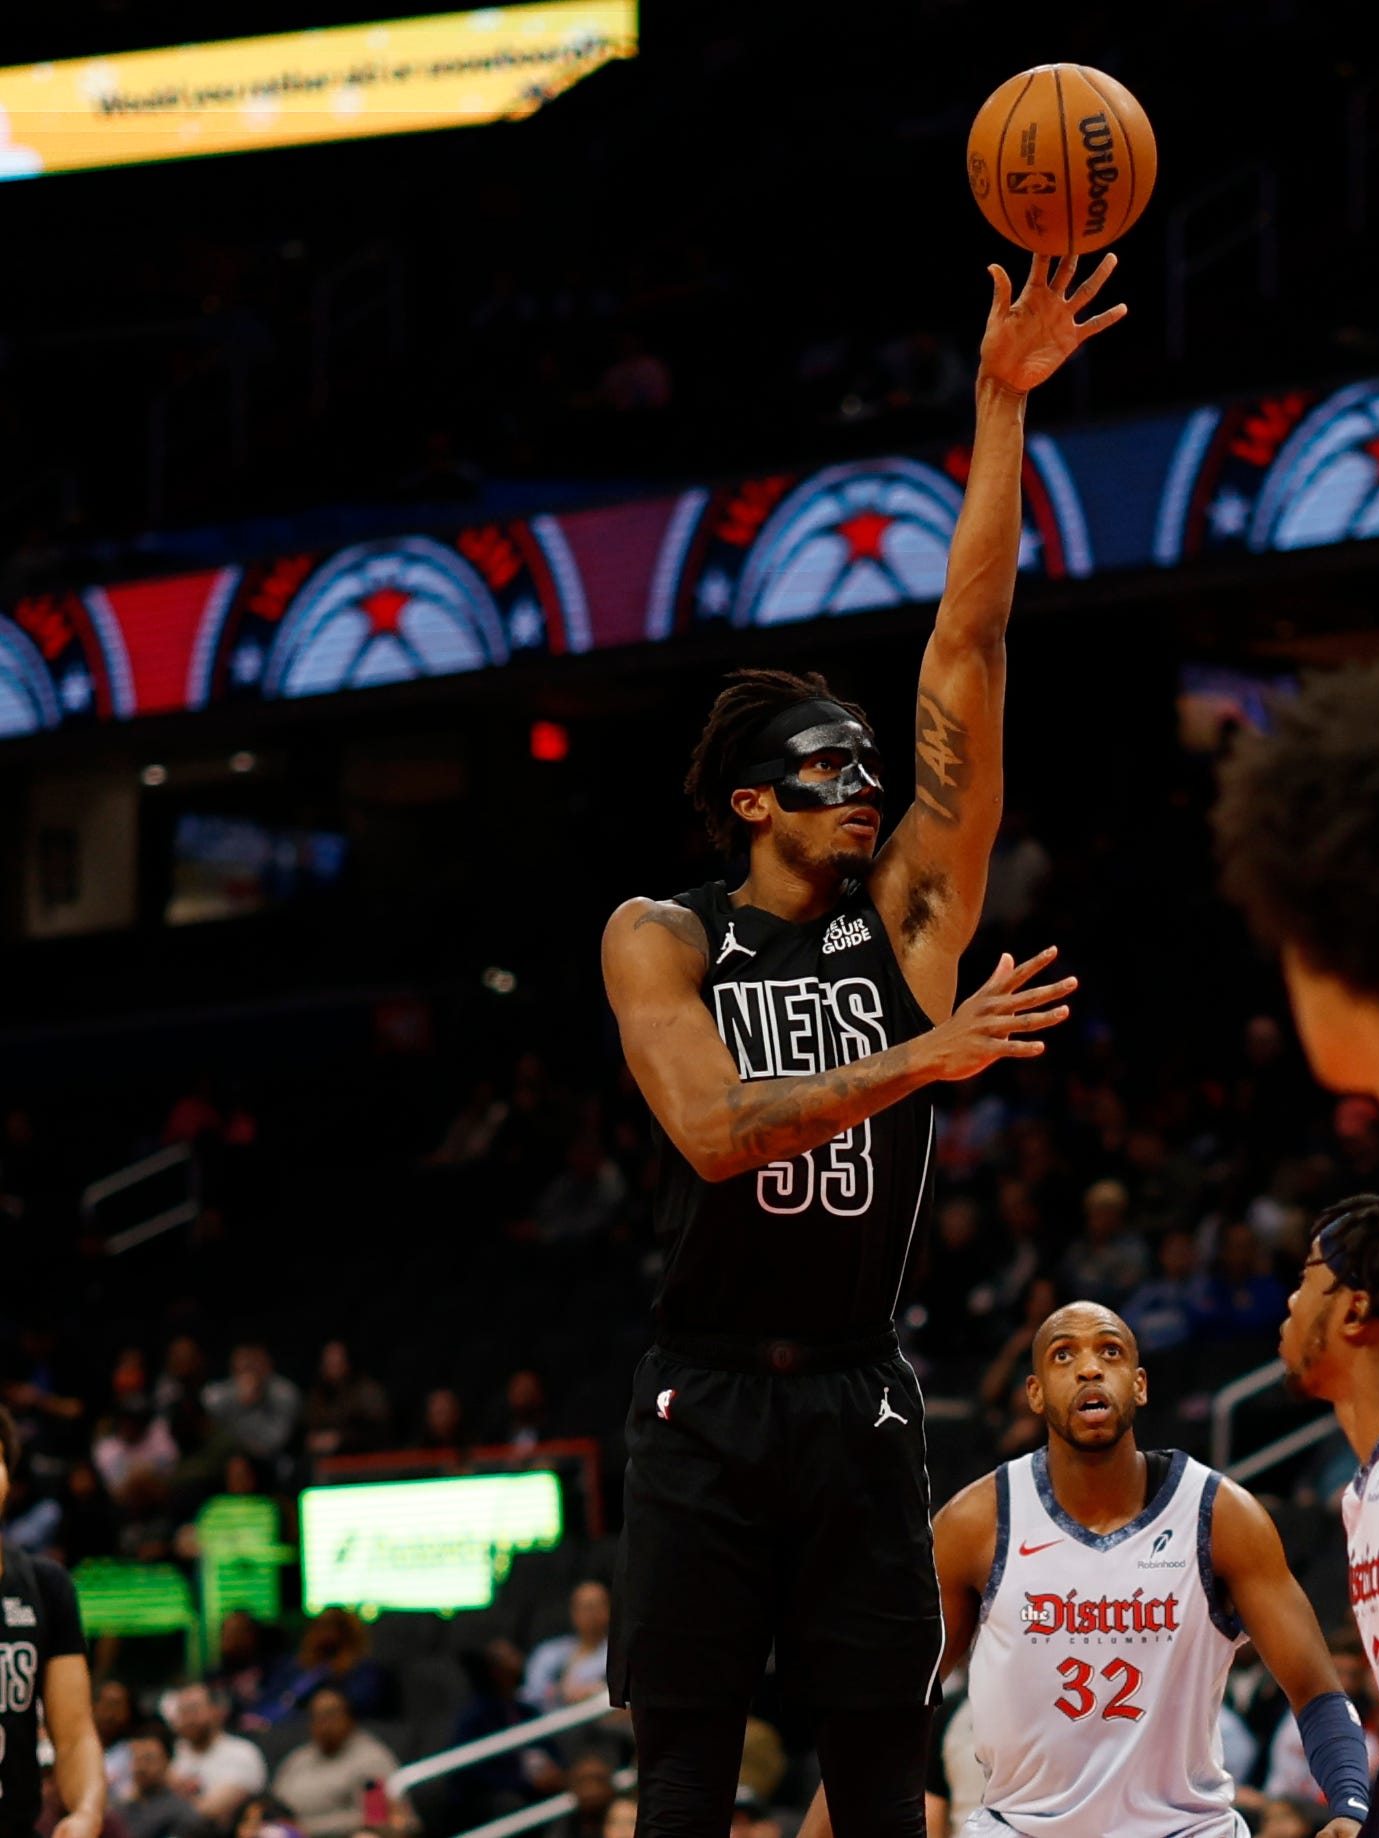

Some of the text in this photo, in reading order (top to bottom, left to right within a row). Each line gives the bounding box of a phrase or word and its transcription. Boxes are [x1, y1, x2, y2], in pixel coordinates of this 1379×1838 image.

[1079, 112, 1119, 237] Wilson
[822, 927, 872, 955] GUIDE
[823, 918, 865, 944] YOUR
[713, 976, 888, 1080] NETS
[1137, 1559, 1186, 1570] Robinhood
[1020, 1587, 1180, 1635] the District
[1069, 1634, 1174, 1645] COLUMBIA
[1053, 1656, 1147, 1722] 32
